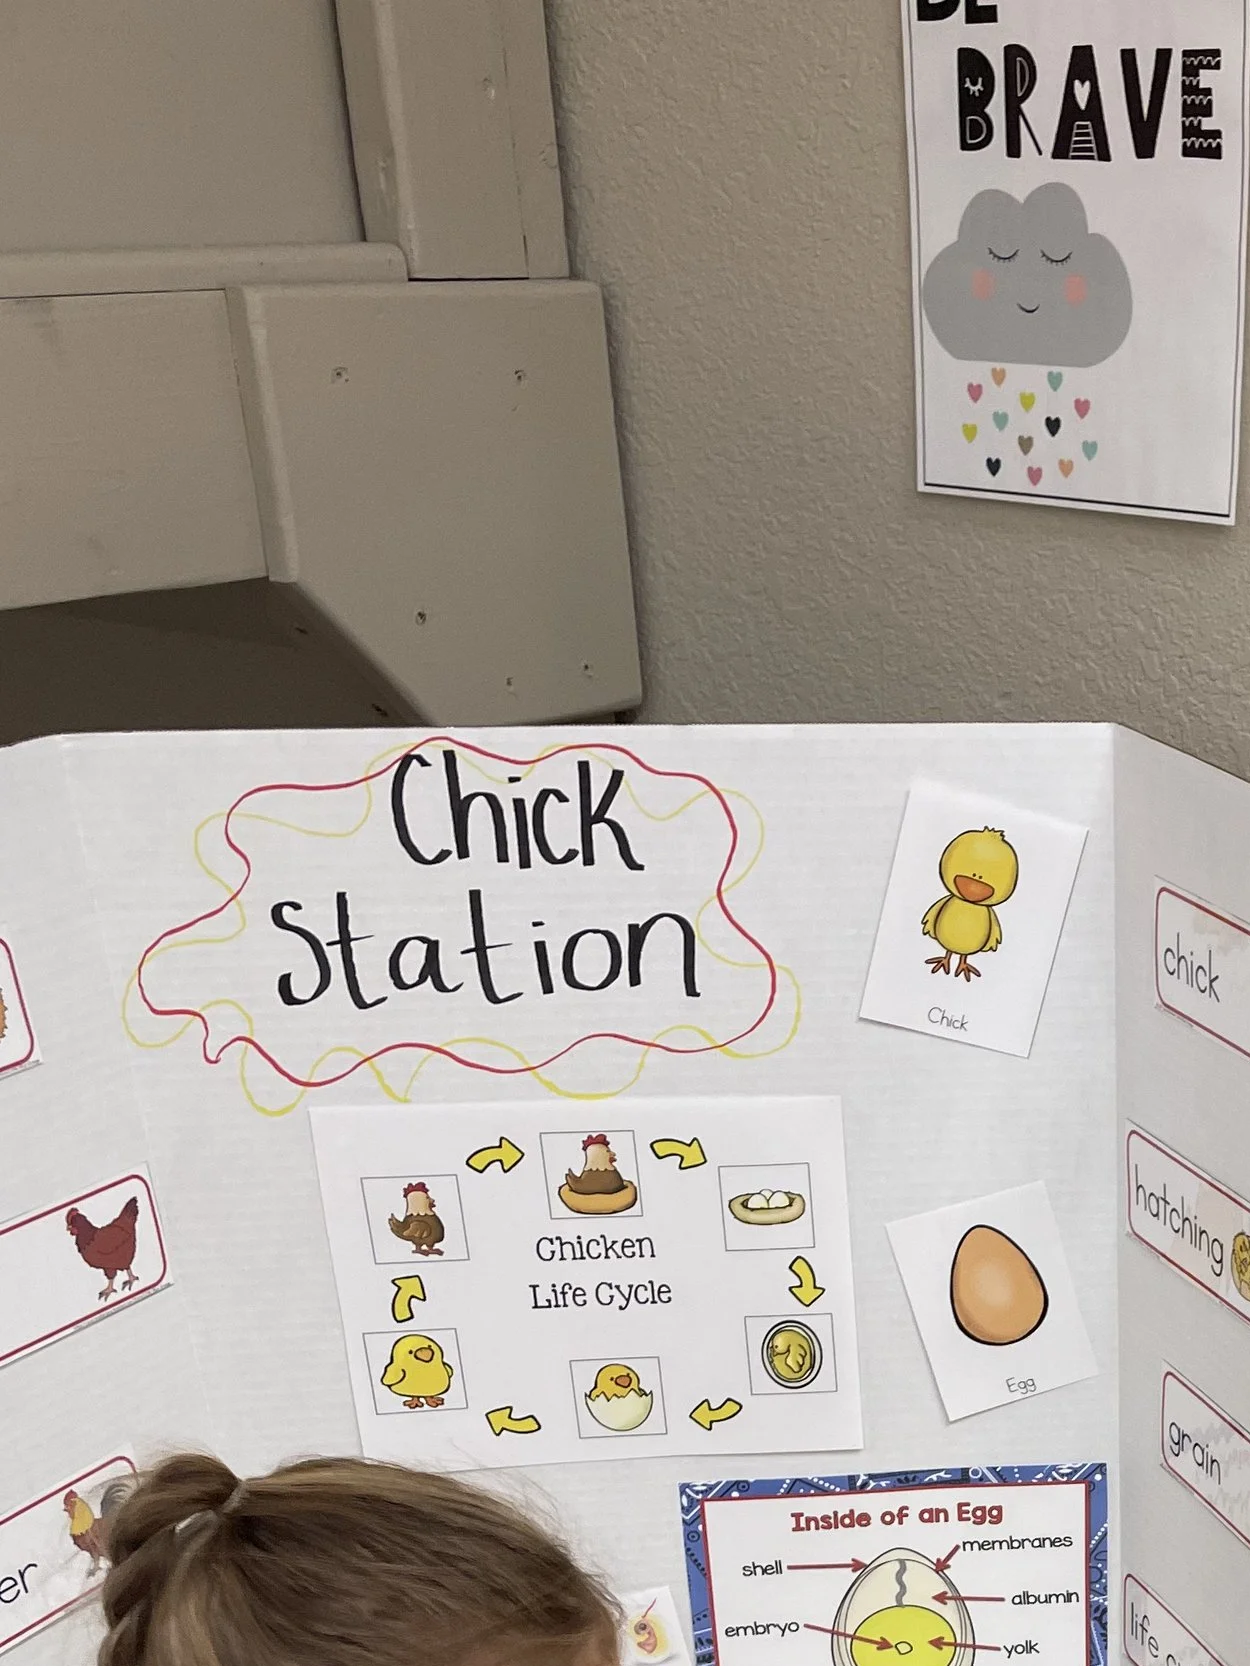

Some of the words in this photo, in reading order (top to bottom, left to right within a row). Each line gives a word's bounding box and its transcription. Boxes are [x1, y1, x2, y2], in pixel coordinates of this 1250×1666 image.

[957, 44, 1223, 162] BRAVE
[391, 750, 645, 871] Chick
[271, 889, 700, 1009] Station
[1164, 932, 1220, 1003] chick
[928, 1006, 969, 1032] Chick
[1135, 1164, 1224, 1277] hatching
[536, 1235, 656, 1262] Chicken
[529, 1283, 587, 1310] Life
[595, 1281, 672, 1311] Cycle
[1006, 1377, 1037, 1394] Egg
[1169, 1420, 1222, 1485] grain
[791, 1508, 872, 1532] Inside
[880, 1505, 909, 1526] of
[918, 1507, 949, 1524] an
[957, 1501, 1004, 1525] Egg
[963, 1535, 1073, 1551] membranes
[743, 1560, 783, 1577] shell
[1012, 1590, 1080, 1606] albumin
[725, 1621, 800, 1639] embryo
[1131, 1602, 1159, 1658] life
[1003, 1639, 1040, 1658] yolk
